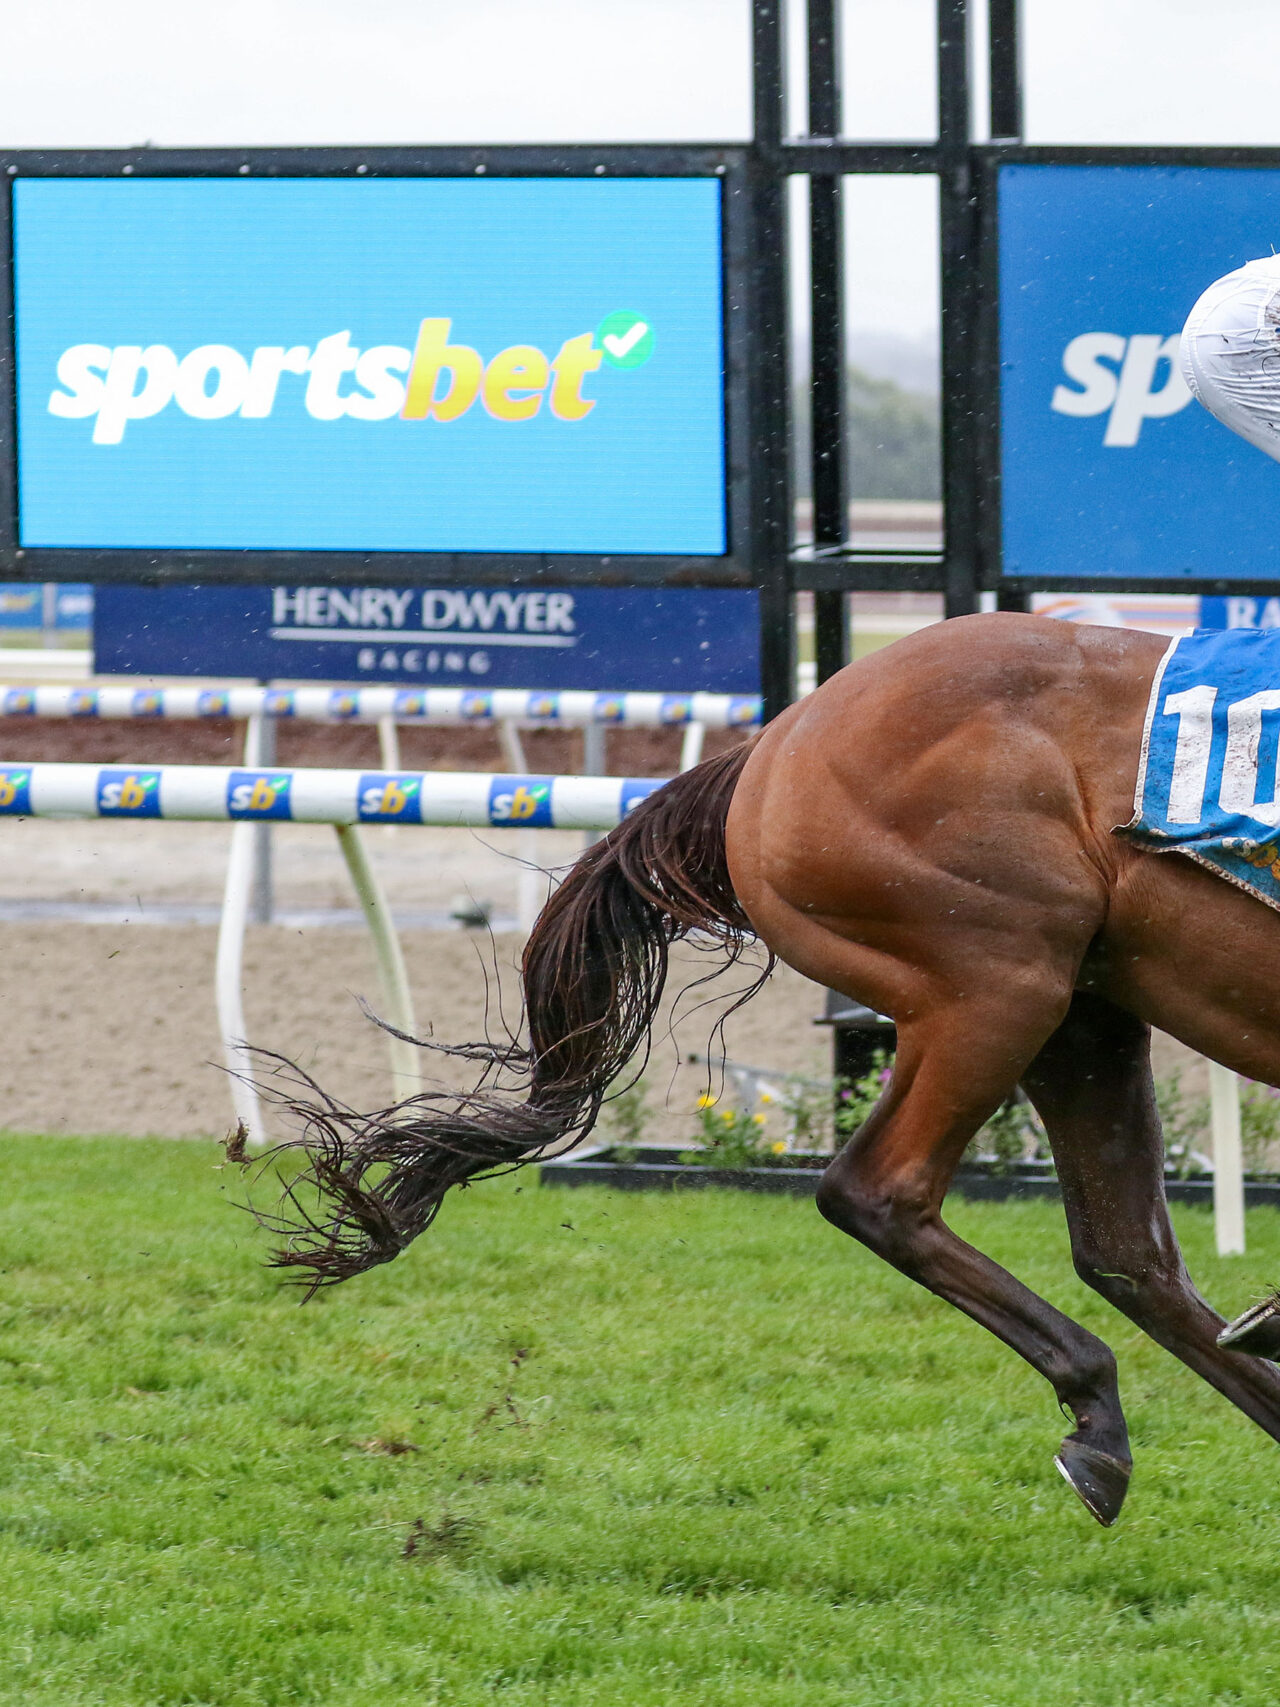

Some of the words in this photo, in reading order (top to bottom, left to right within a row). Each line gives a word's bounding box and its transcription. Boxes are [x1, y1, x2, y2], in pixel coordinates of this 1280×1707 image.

[47, 318, 604, 444] sportsbet
[272, 586, 414, 628] HENRY
[421, 588, 577, 633] DWYER
[357, 647, 492, 675] RACING
[100, 776, 146, 809] sb
[230, 778, 276, 811] sb
[360, 780, 407, 814] sb
[490, 786, 537, 820] sb
